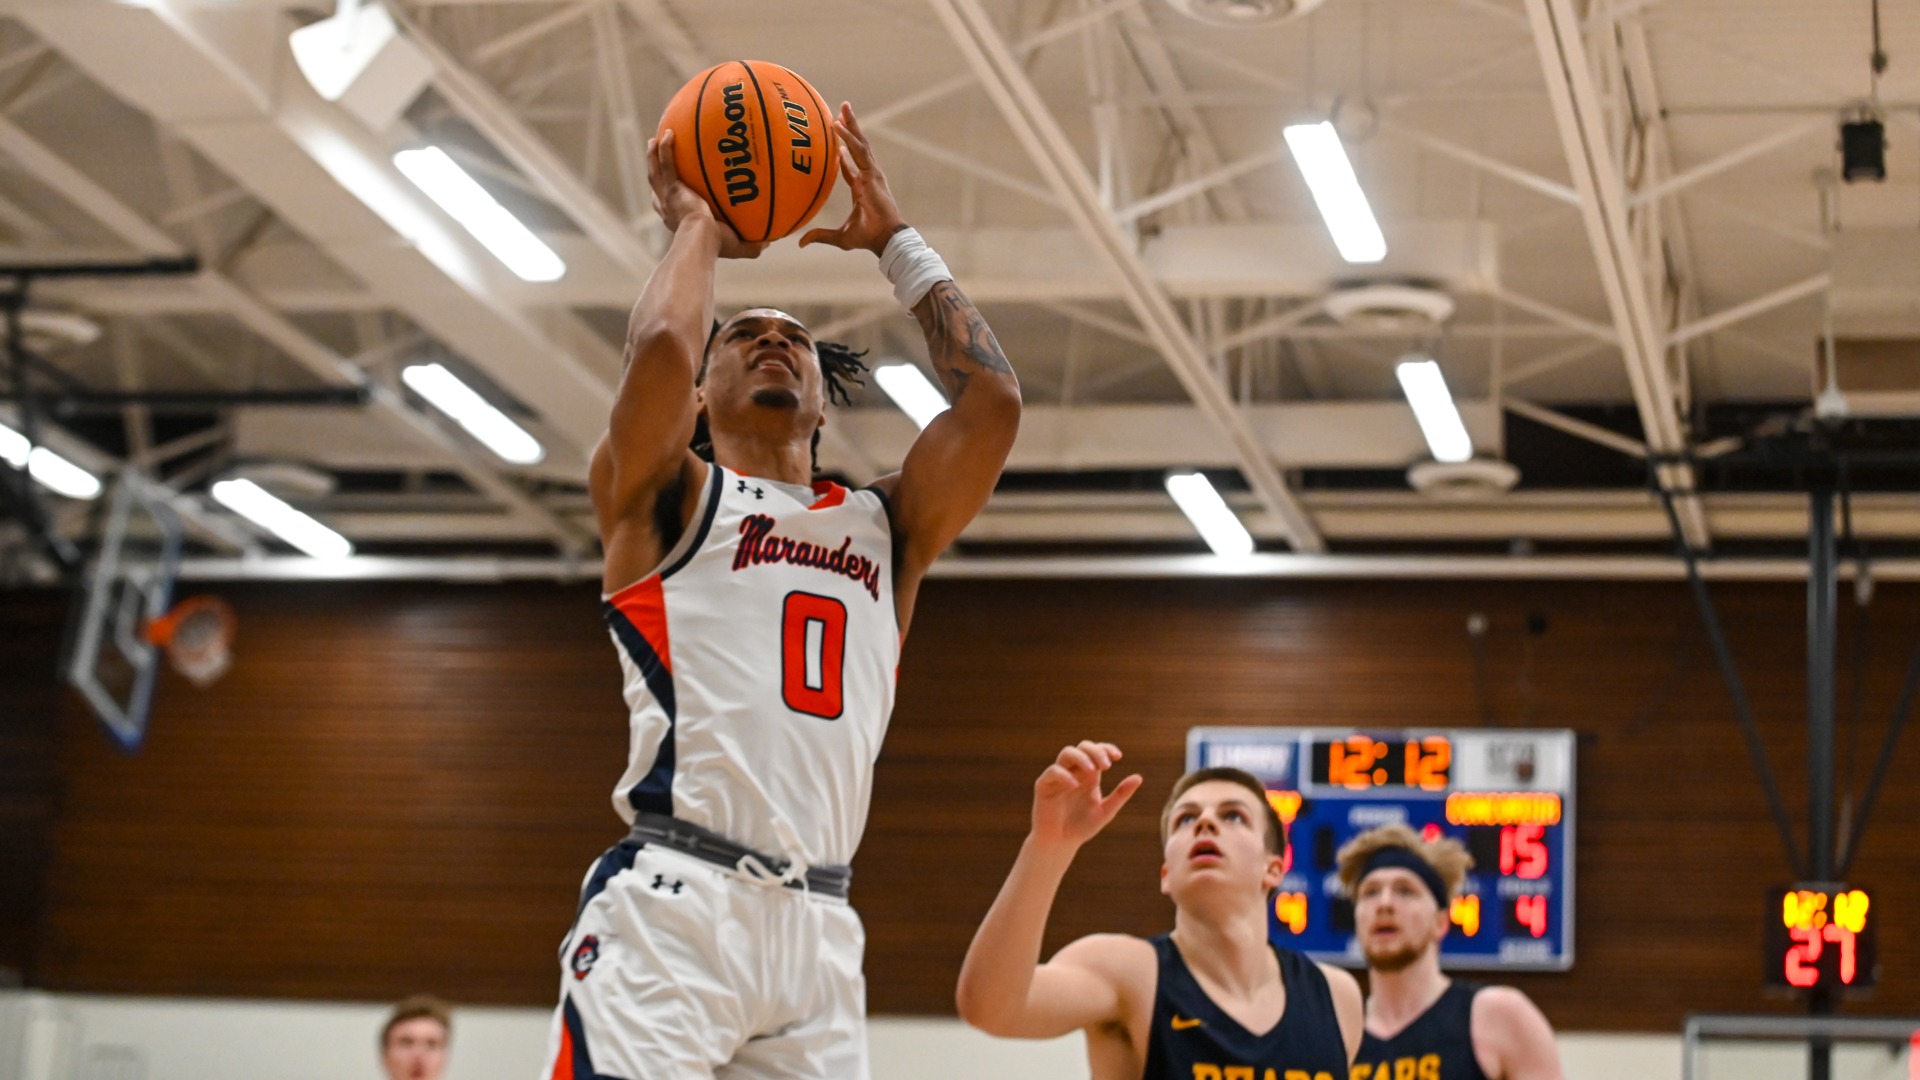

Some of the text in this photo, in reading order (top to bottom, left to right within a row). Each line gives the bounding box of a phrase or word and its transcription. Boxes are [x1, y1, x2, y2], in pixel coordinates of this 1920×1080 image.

[718, 81, 759, 207] Wilson
[782, 100, 812, 175] EVO
[732, 513, 880, 602] Marauders
[781, 590, 847, 721] 0
[1329, 735, 1452, 791] 12:12
[1500, 823, 1548, 879] 15
[1515, 894, 1547, 938] 4
